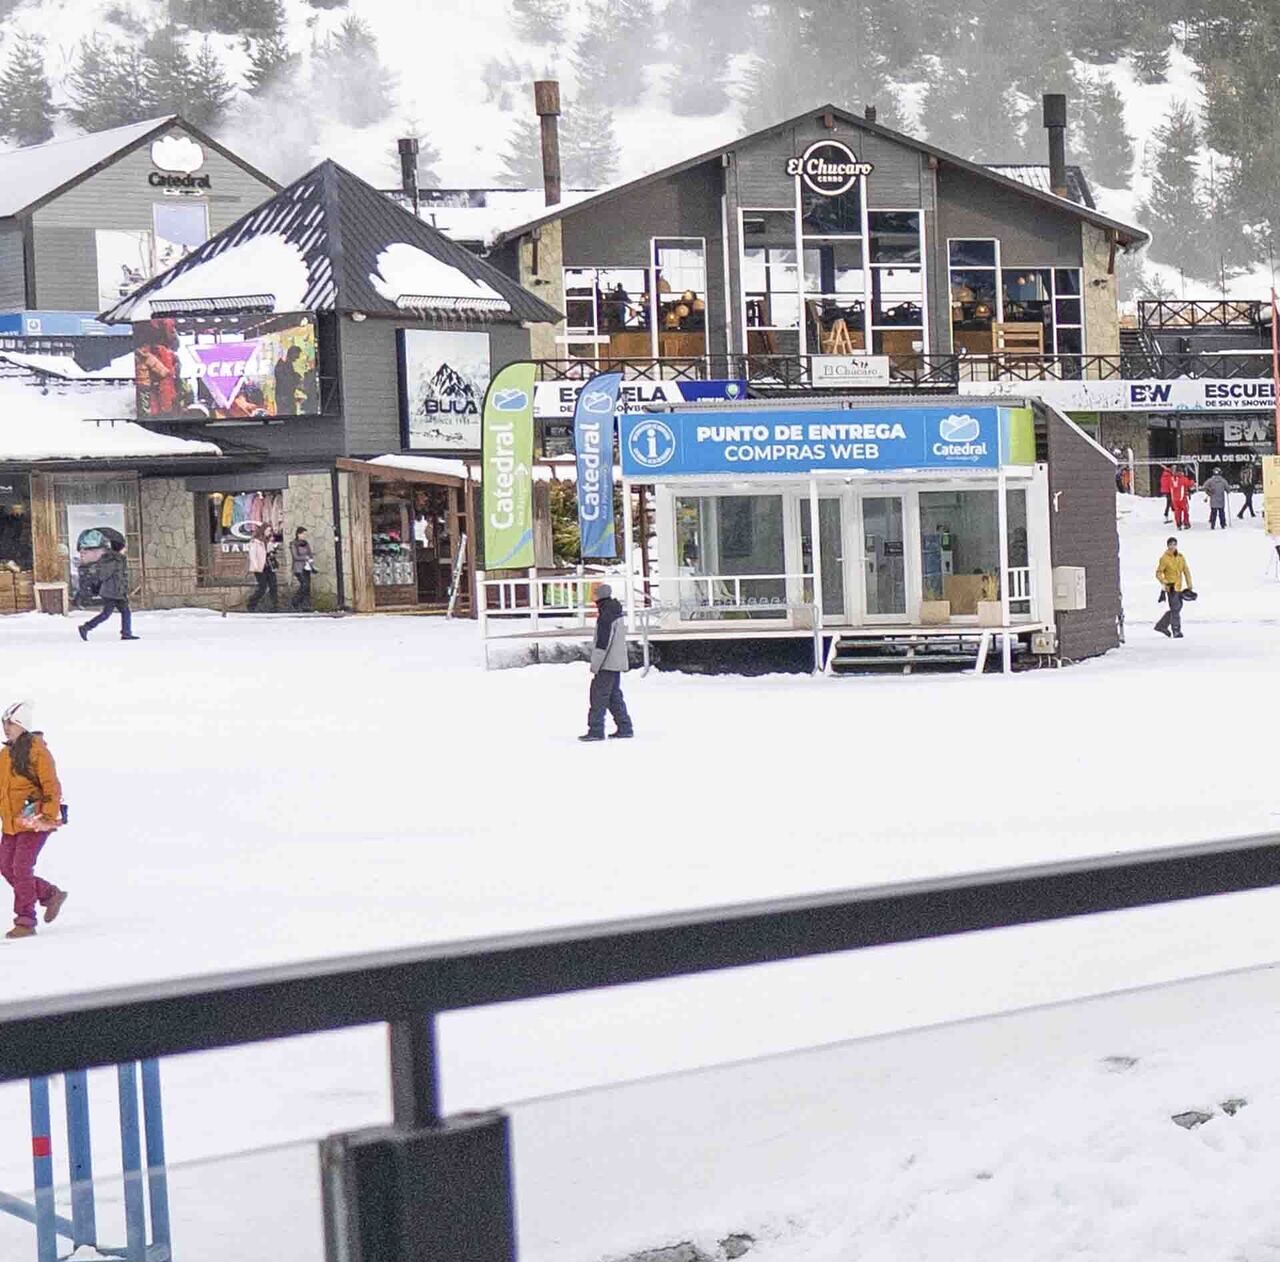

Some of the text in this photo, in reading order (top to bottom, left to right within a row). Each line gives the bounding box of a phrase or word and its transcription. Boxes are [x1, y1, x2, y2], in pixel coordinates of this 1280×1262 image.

[787, 158, 873, 175] El Chucaro
[148, 172, 212, 188] Catedral
[1205, 384, 1278, 398] ESCUEL
[697, 423, 906, 442] PUNTO DE ENTREGA
[724, 443, 880, 462] COMPRAS WEB
[932, 443, 988, 456] Catedral
[1222, 453, 1235, 462] DE
[490, 422, 513, 529] Catedral
[579, 422, 600, 521] Catedral
